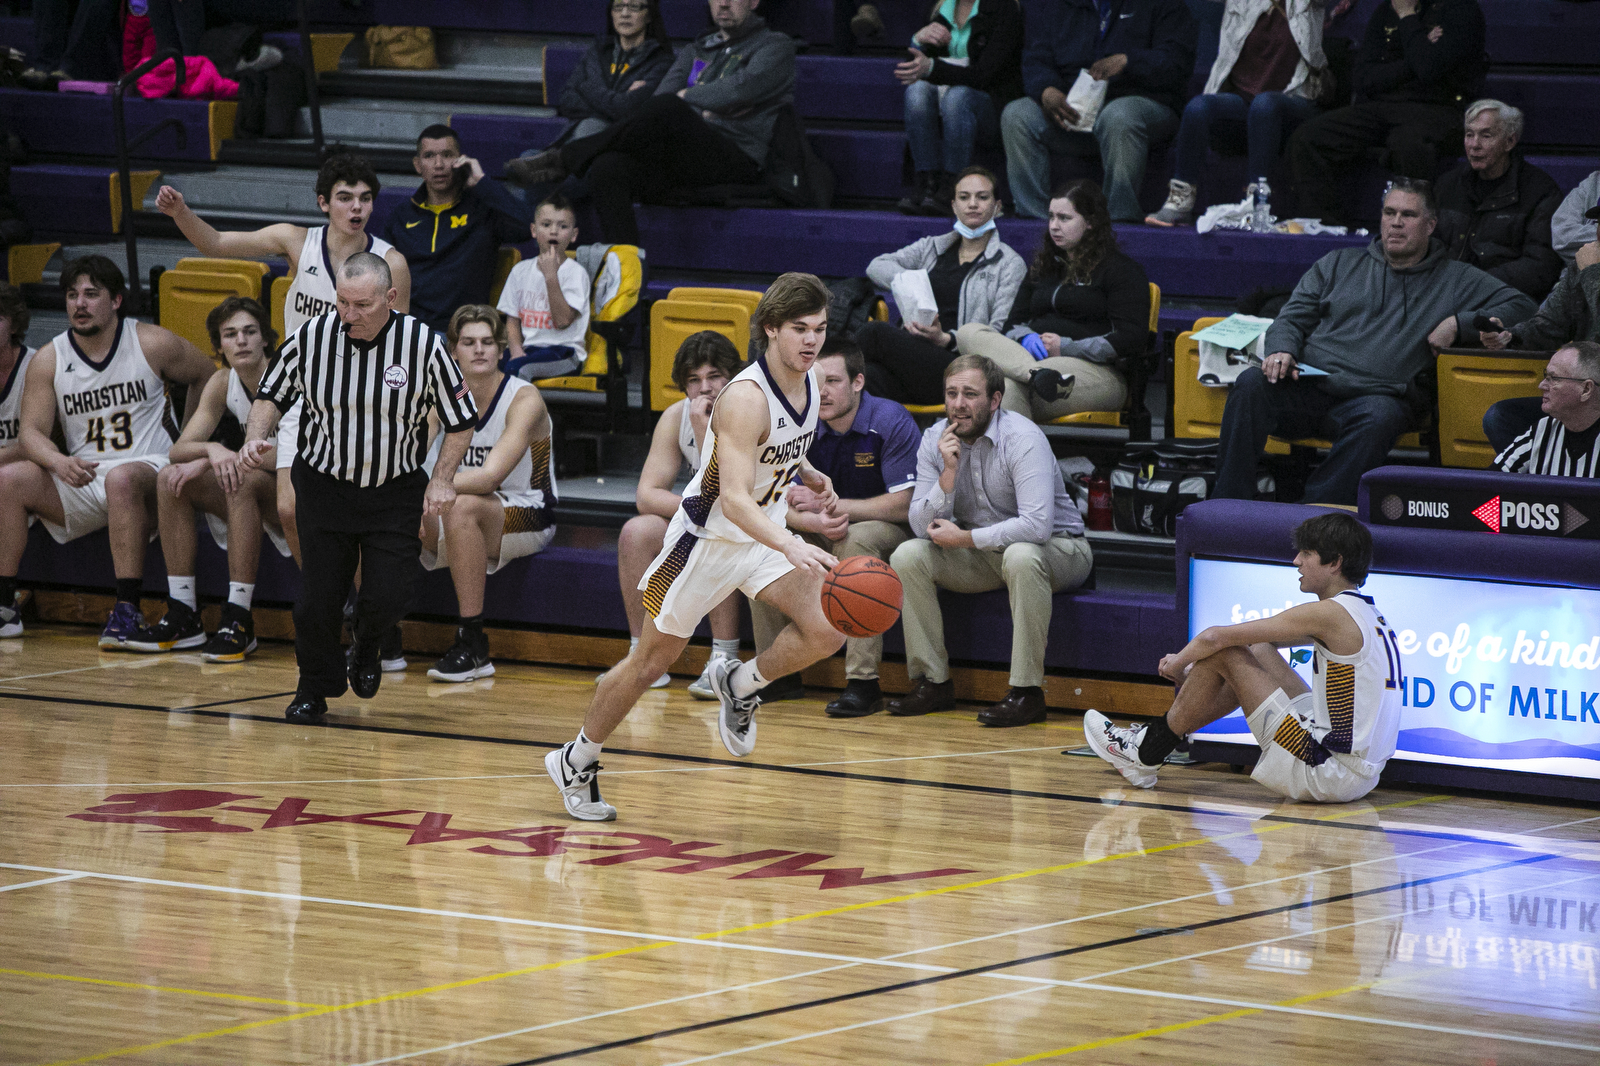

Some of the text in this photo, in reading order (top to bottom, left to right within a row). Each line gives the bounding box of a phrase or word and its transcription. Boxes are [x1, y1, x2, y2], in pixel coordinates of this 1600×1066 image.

[450, 214, 468, 229] M
[63, 380, 148, 416] CHRISTIAN
[86, 410, 133, 452] 43
[1408, 500, 1449, 518] BONUS
[1501, 501, 1559, 531] POSS
[1426, 622, 1472, 675] of
[1476, 635, 1508, 663] a
[1510, 629, 1600, 671] kind
[1449, 680, 1494, 713] OF
[1508, 685, 1600, 724] MILK
